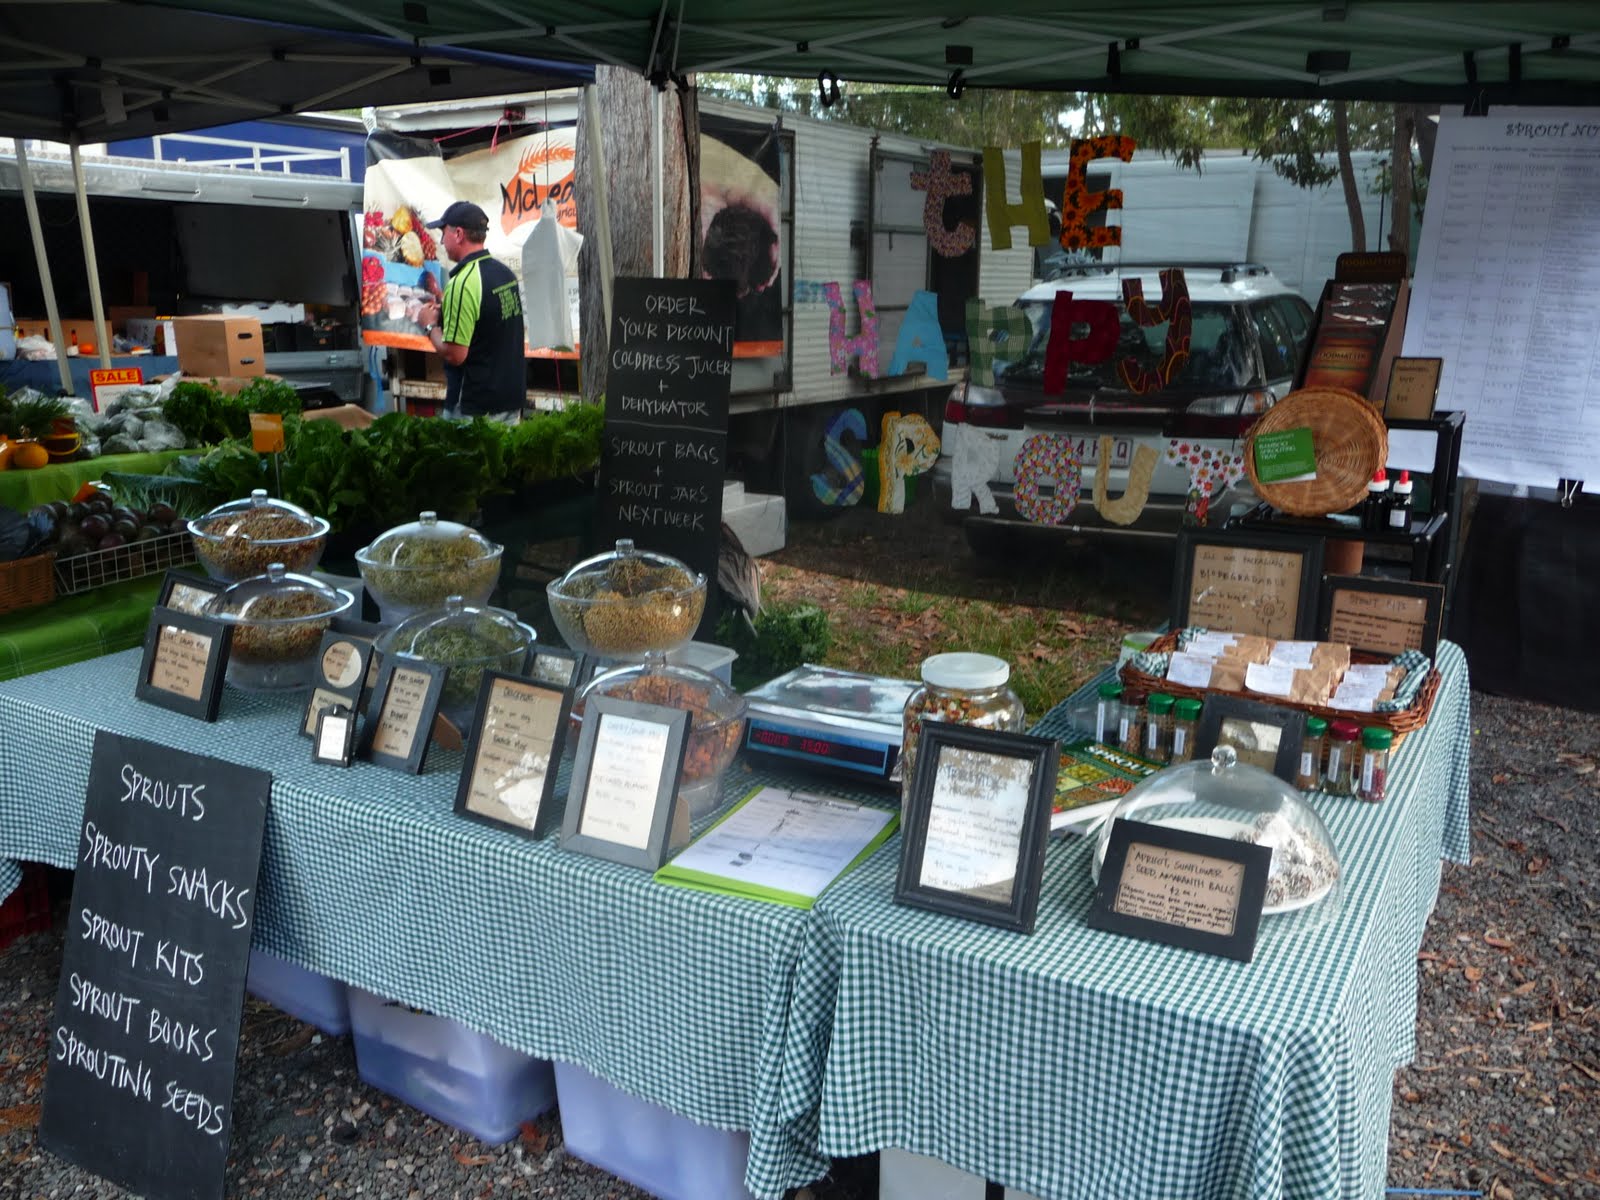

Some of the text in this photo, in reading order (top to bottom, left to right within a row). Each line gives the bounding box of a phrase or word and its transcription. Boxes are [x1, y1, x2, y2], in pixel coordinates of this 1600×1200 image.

[1505, 122, 1569, 138] SPROUT
[646, 295, 706, 315] ORDER
[619, 317, 734, 352] YOUR DISCOUNT
[95, 370, 137, 382] SALE
[613, 349, 731, 379] COLDPRESS JUICER
[622, 395, 709, 418] DEHYDRATOR
[611, 436, 719, 464] SPROUT BAGS
[811, 408, 1247, 527] SPROUT
[609, 479, 709, 504] SPROUT JARS
[618, 504, 704, 532] NEXT WEEK
[120, 764, 206, 821] SPROUTS
[84, 821, 249, 929] SPROUTY SNACKS
[1174, 860, 1222, 877] SUNFLOWER
[1159, 872, 1204, 888] AMARANTH
[1208, 881, 1235, 896] BALLS
[81, 908, 204, 985] SPROUT KITS
[70, 972, 217, 1062] SPROUT BOOKS
[56, 1026, 224, 1134] SPROUTING SEEDS
